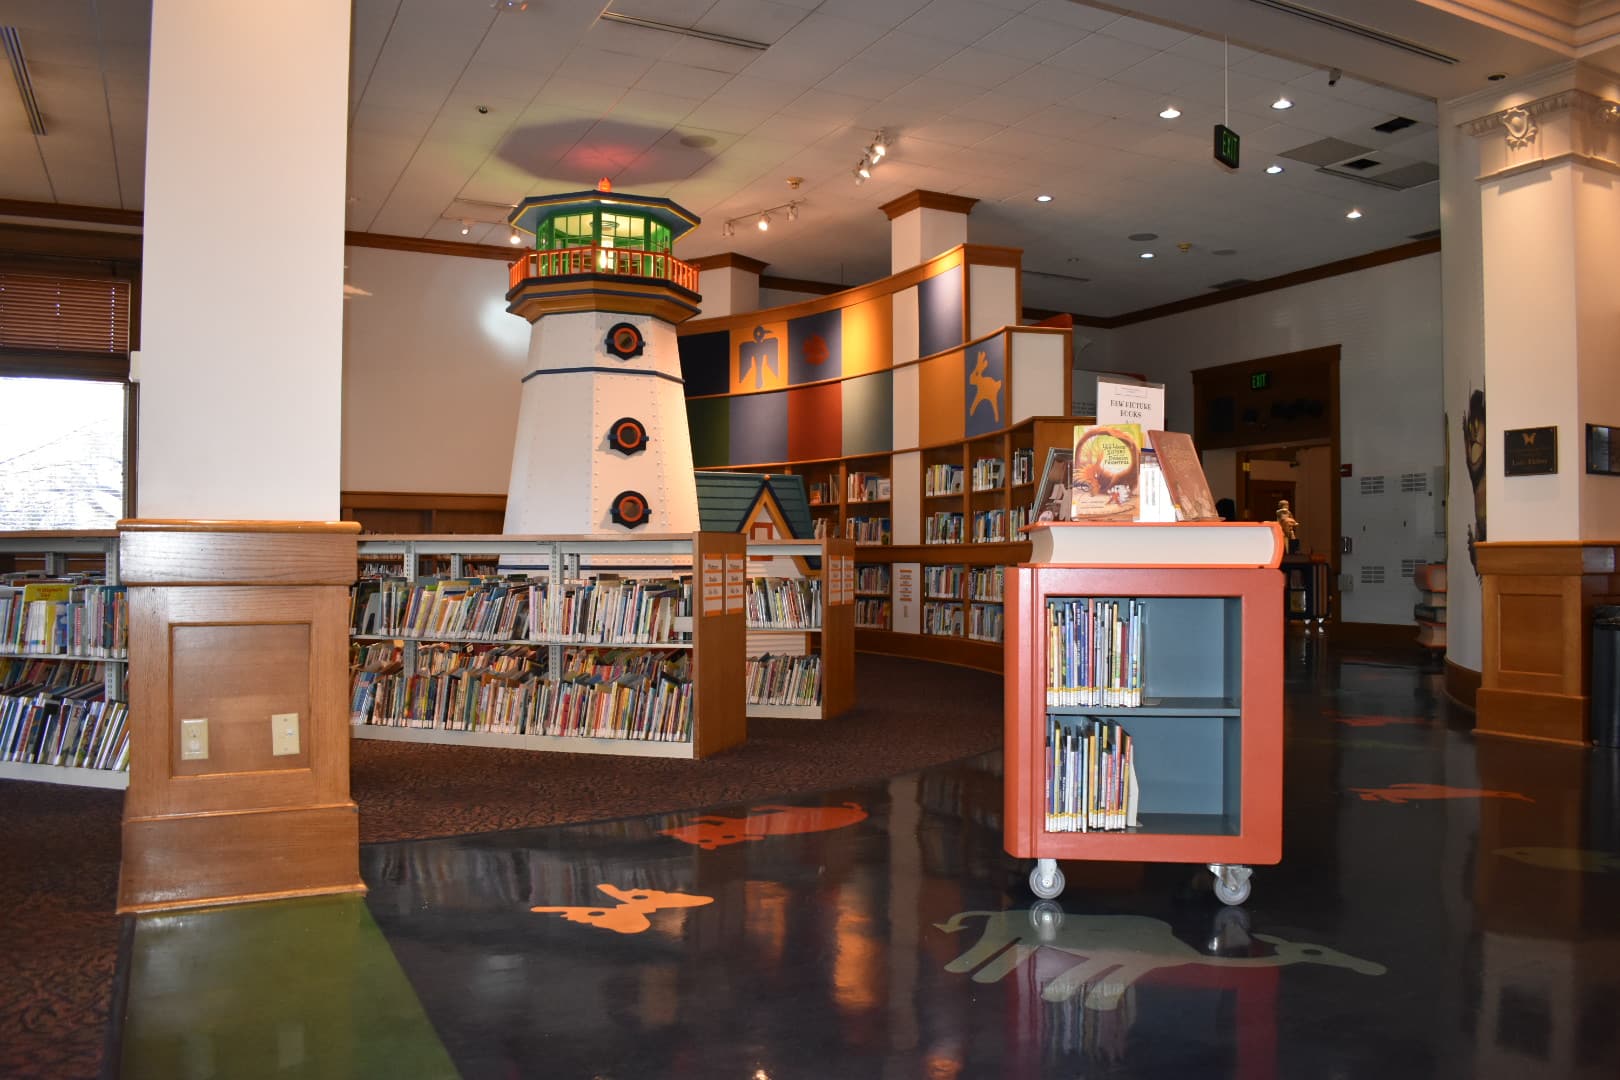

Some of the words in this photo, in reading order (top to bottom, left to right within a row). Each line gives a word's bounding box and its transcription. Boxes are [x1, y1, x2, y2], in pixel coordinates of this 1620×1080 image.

[1222, 130, 1238, 161] EXIT
[1252, 373, 1267, 389] EXIT
[1125, 401, 1152, 410] PICTURE
[1120, 409, 1142, 418] BOOKS
